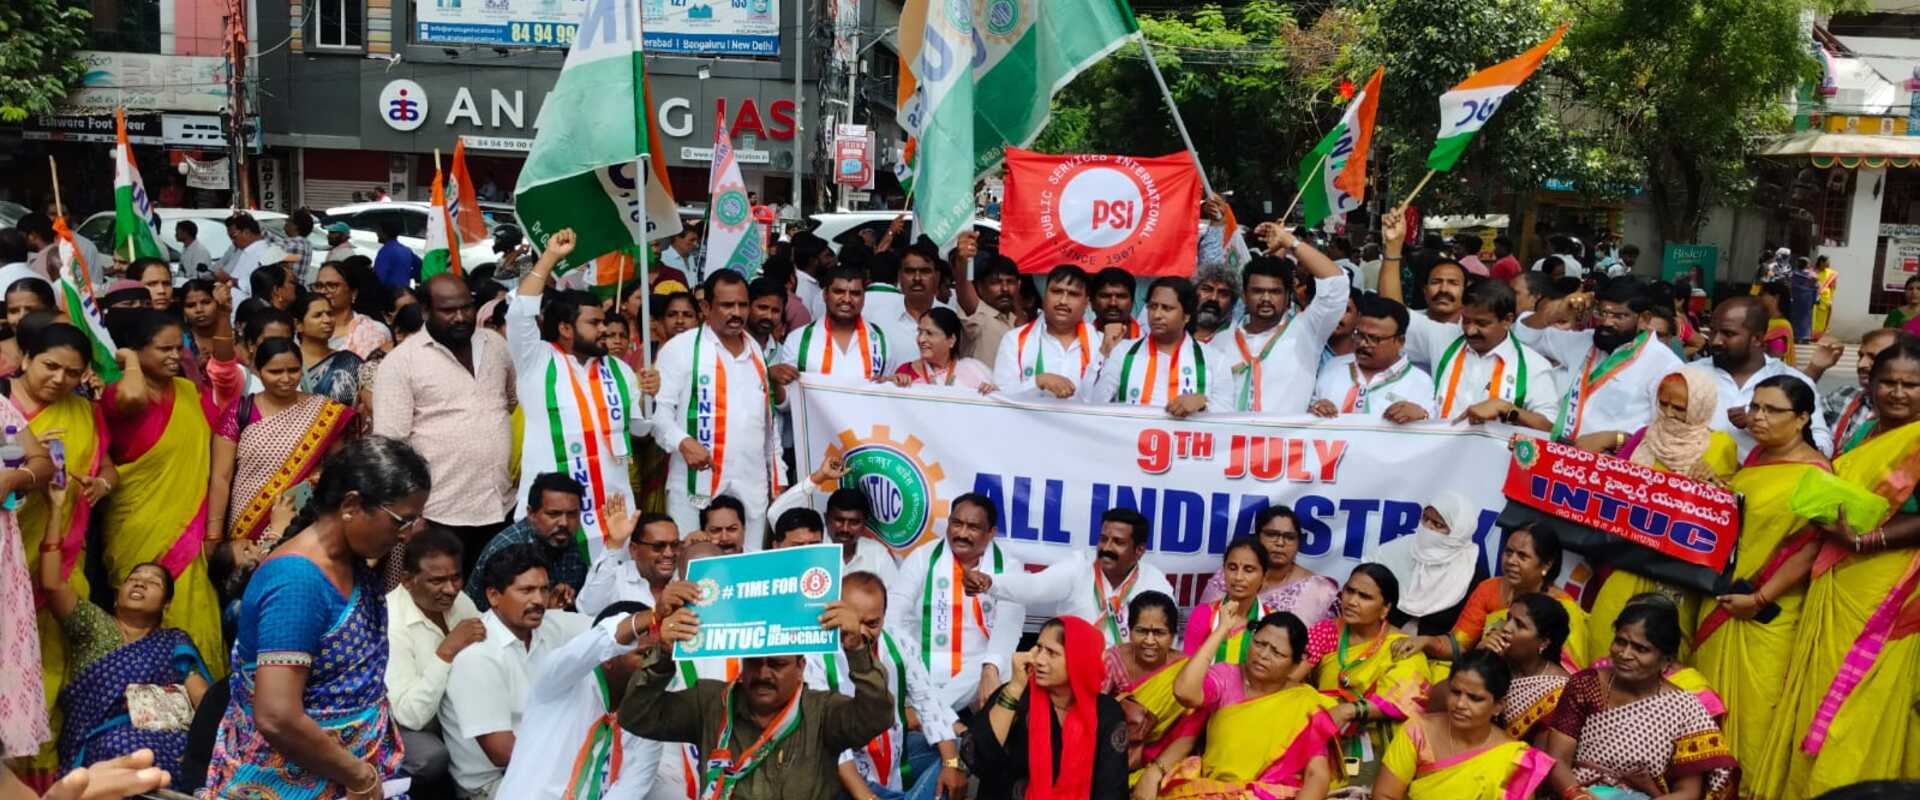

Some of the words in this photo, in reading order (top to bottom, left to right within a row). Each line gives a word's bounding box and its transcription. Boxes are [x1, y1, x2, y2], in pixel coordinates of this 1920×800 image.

[511, 23, 530, 43] 84
[534, 23, 552, 43] 94
[556, 24, 576, 44] 99
[644, 38, 672, 48] erabad
[683, 39, 726, 51] Bengaluru
[732, 40, 750, 50] New
[752, 40, 773, 51] Delhi
[88, 117, 113, 129] Foot
[1040, 190, 1056, 240] PUBLIC
[1115, 154, 1161, 238] INTERNATIONAL
[1091, 199, 1135, 231] PSI
[1136, 427, 1215, 475] 9TH
[1224, 434, 1349, 483] JULY
[972, 471, 1071, 544] ALL
[1089, 482, 1271, 555] INDIA
[1531, 475, 1718, 554] INTUC
[737, 580, 770, 599] TIME
[772, 576, 799, 595] FOR
[705, 626, 767, 651] INTUC
